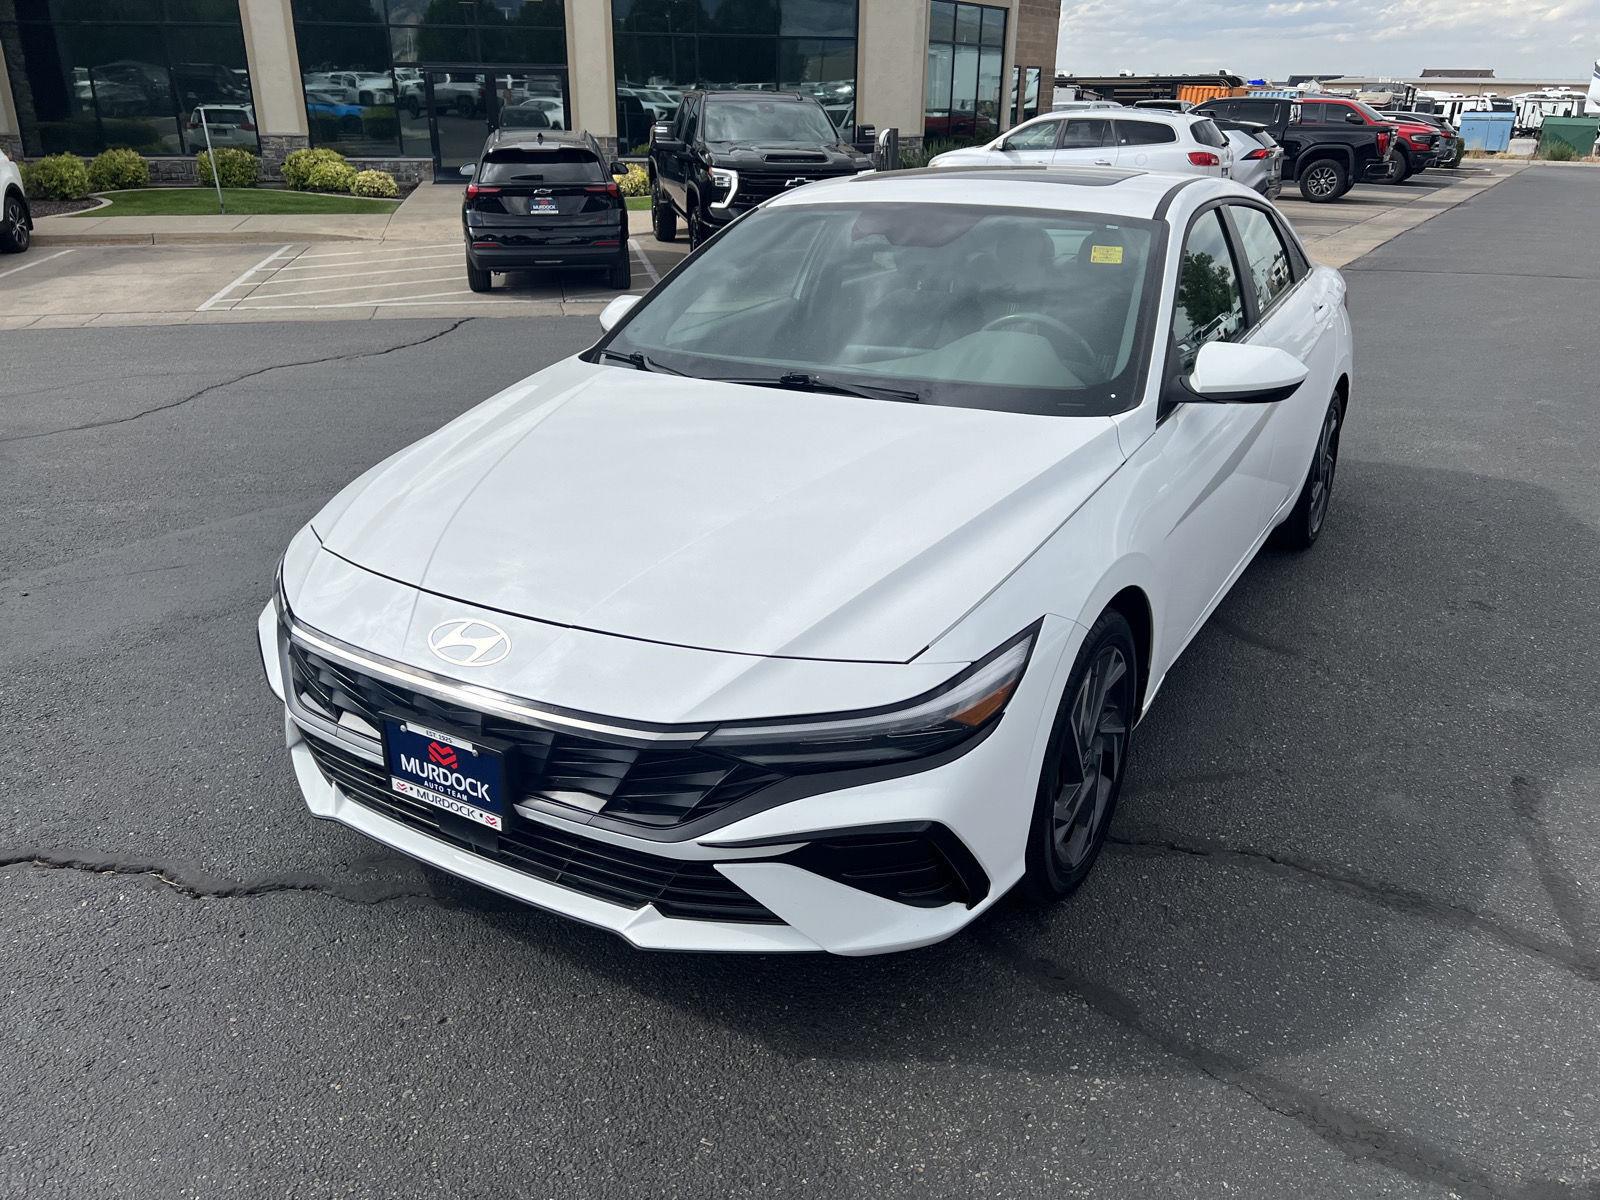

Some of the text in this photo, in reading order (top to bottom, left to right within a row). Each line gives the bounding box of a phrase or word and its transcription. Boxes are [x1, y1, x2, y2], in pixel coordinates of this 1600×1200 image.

[400, 754, 491, 802] MURDOCK
[424, 780, 468, 802] AUTO TEAM
[416, 788, 476, 820] MURDOCK
